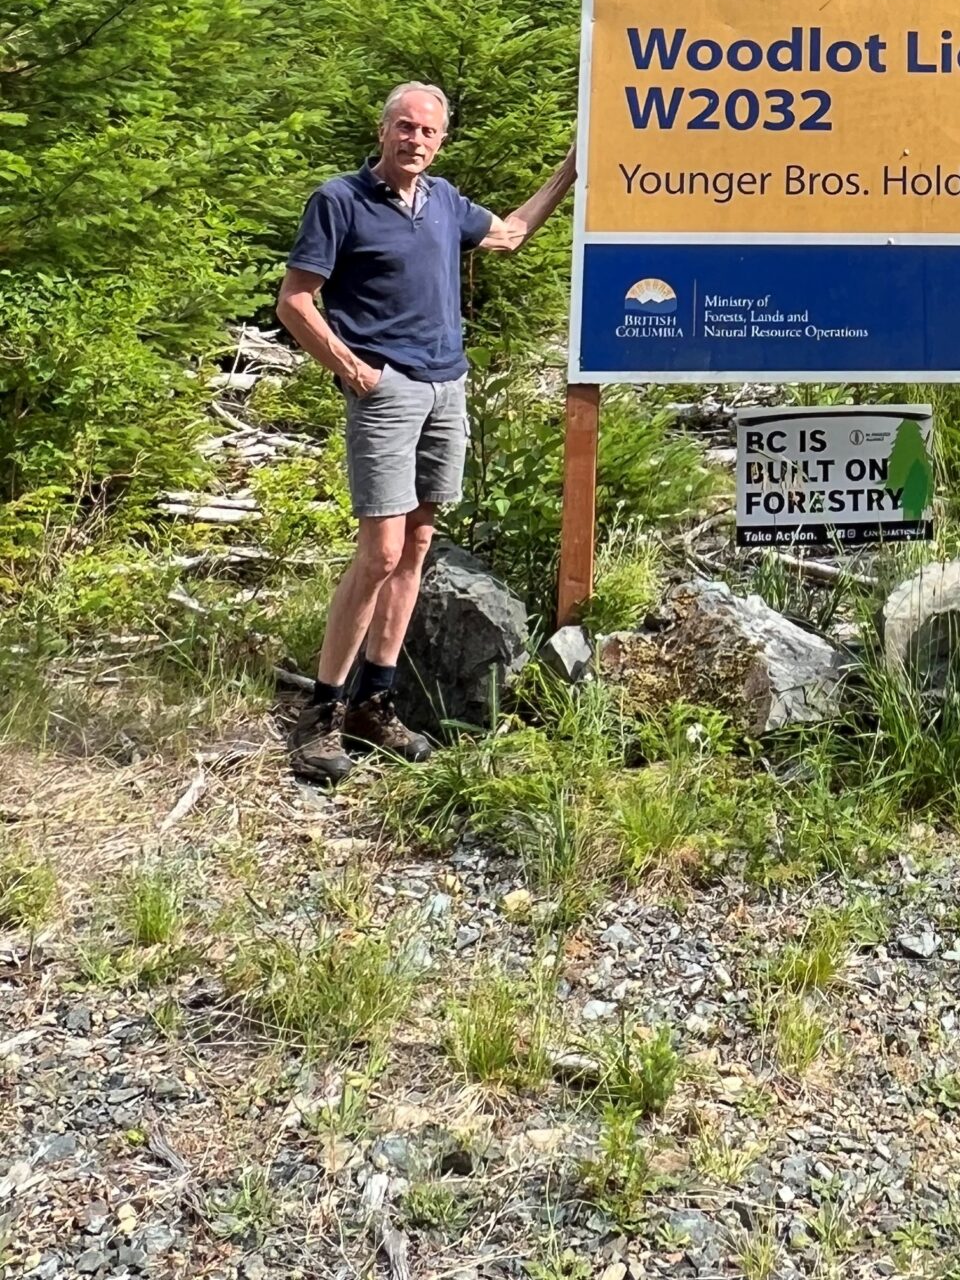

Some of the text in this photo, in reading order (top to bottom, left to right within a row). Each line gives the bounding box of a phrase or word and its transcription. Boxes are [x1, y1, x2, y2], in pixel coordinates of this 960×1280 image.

[627, 27, 887, 72] Woodlot
[625, 86, 832, 131] W2032
[618, 163, 772, 203] Younger
[785, 165, 869, 196] Bros.
[704, 294, 770, 310] Ministry of
[624, 315, 676, 326] BRITISH
[704, 310, 809, 324] Forests, Lands and
[615, 325, 684, 338] COLUMBIA
[704, 324, 868, 341] Natural Resource Operations
[746, 429, 827, 454] BC IS
[746, 458, 888, 485] BUILT ON
[745, 487, 904, 515] FORESTRY
[744, 531, 773, 542] Take
